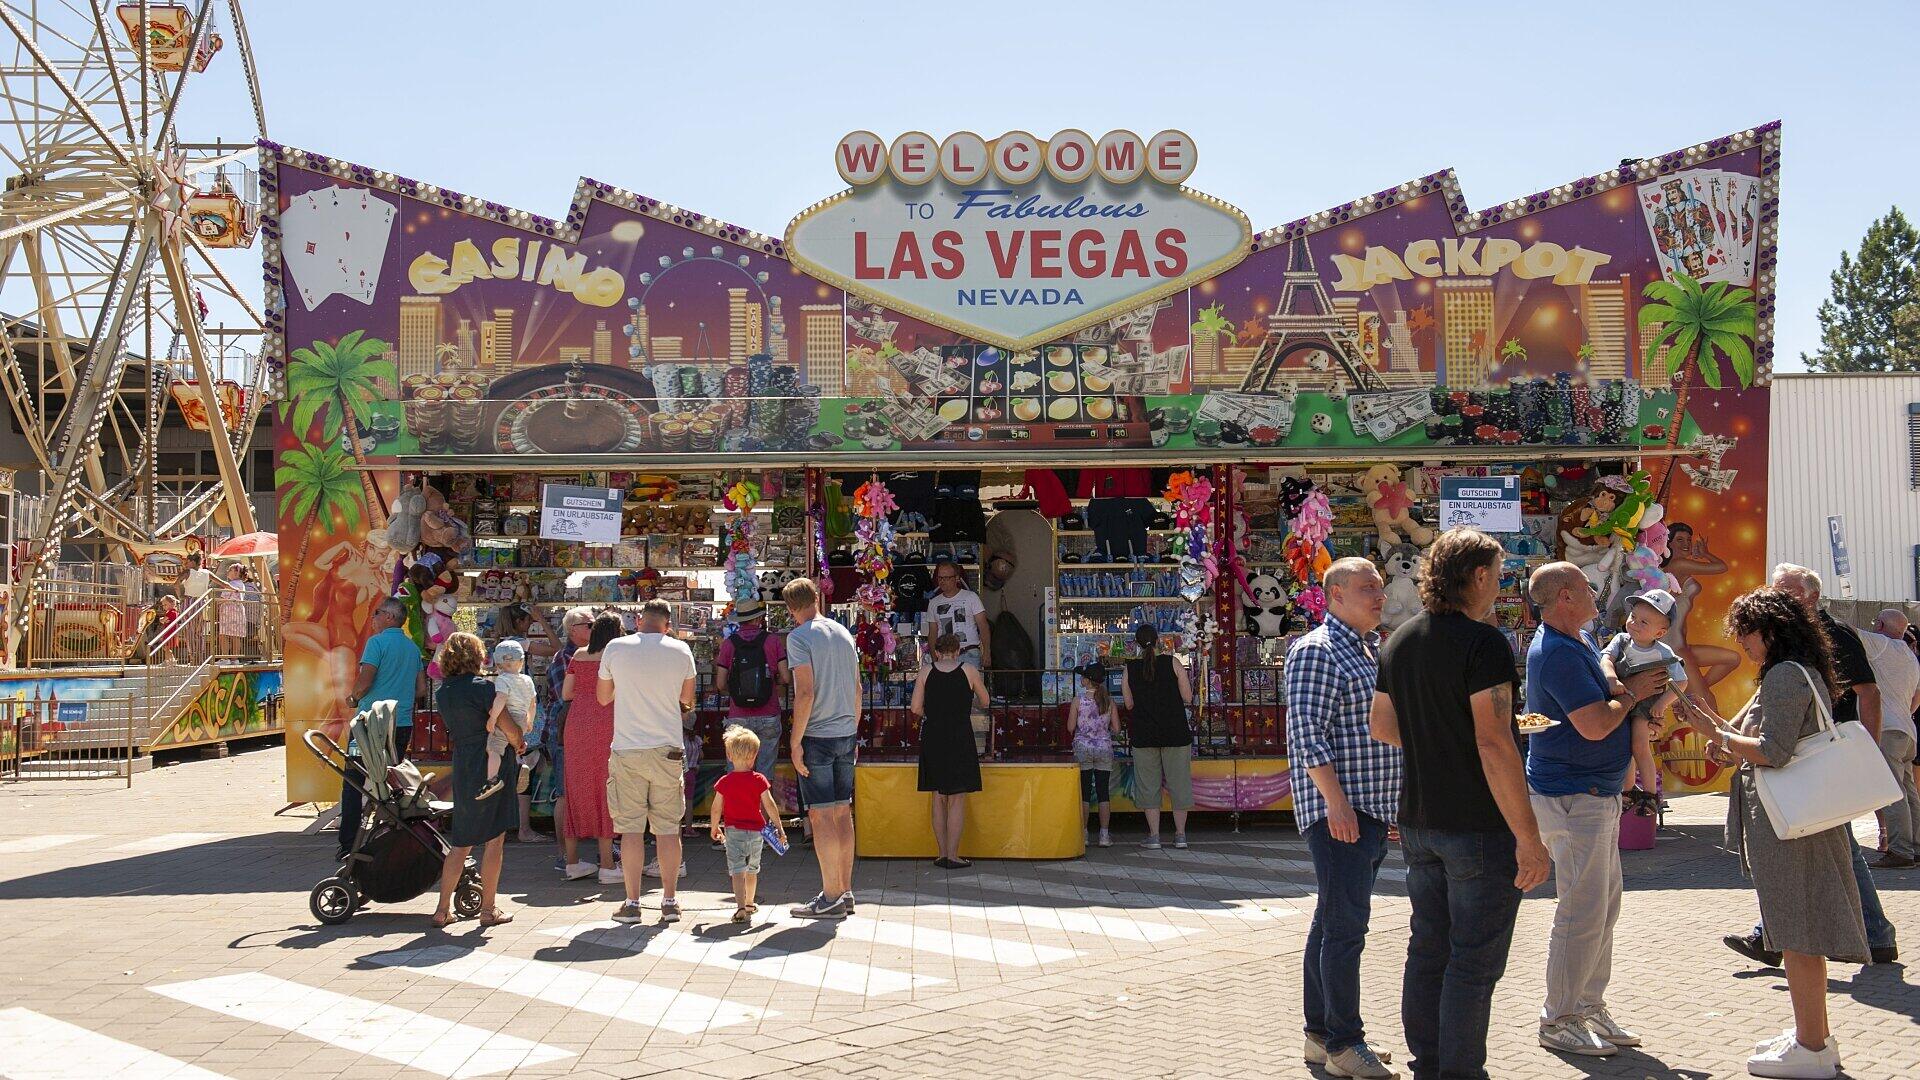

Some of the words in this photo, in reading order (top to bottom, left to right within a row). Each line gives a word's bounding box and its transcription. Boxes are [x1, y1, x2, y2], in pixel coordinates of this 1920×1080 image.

[842, 140, 1183, 173] WELCOME
[905, 203, 934, 220] TO
[953, 189, 1150, 220] Fabulous
[854, 230, 965, 280] LAS
[984, 228, 1189, 279] VEGAS
[1330, 237, 1612, 292] JACKPOT
[408, 237, 625, 308] CASINO
[957, 288, 1084, 306] NEVADA
[553, 509, 565, 517] EIN
[566, 499, 602, 507] GUTSCHEIN
[1448, 501, 1460, 509] EIN
